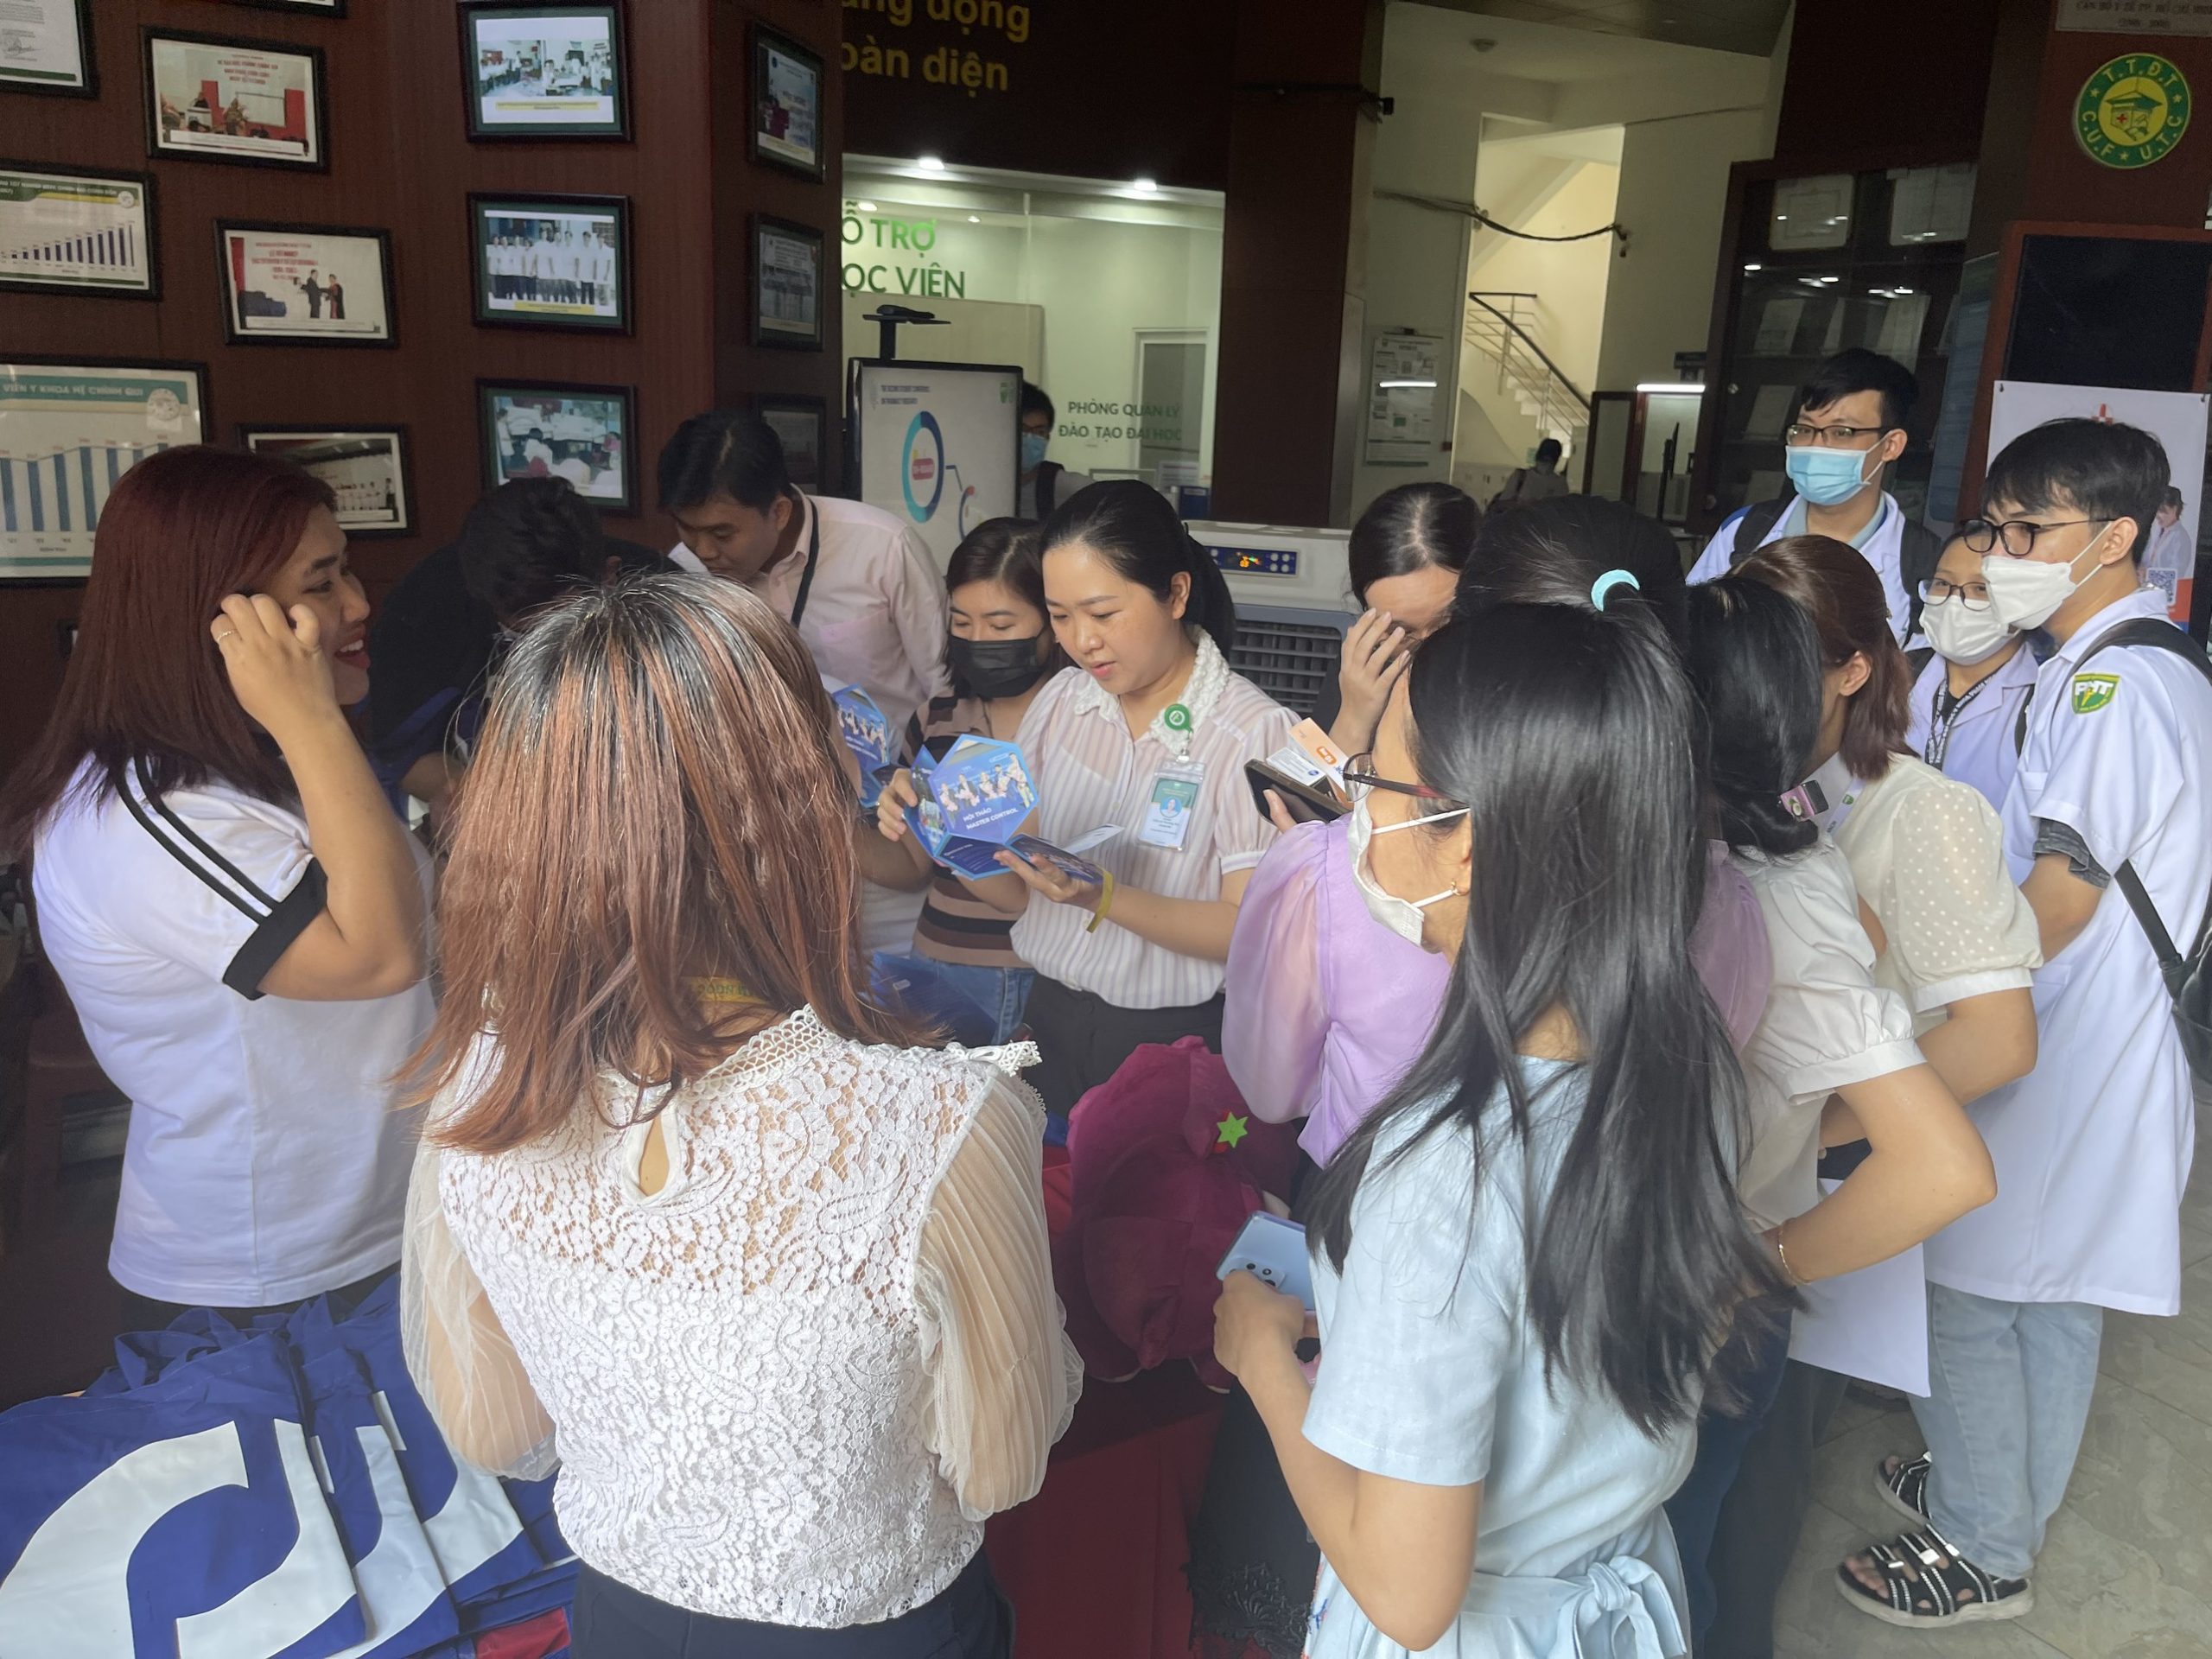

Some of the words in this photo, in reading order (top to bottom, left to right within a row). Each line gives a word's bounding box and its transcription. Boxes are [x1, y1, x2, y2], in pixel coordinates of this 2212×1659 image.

[922, 47, 1007, 98] diện
[870, 218, 938, 258] TRỢ
[842, 264, 887, 298] ỌC
[895, 262, 965, 299] VIÊN
[1068, 398, 1119, 415] PHÒNG
[1058, 422, 1090, 437] ĐÀO
[1095, 426, 1122, 442] TẠO
[966, 817, 990, 830] MASTER
[990, 807, 1019, 821] CONTROL
